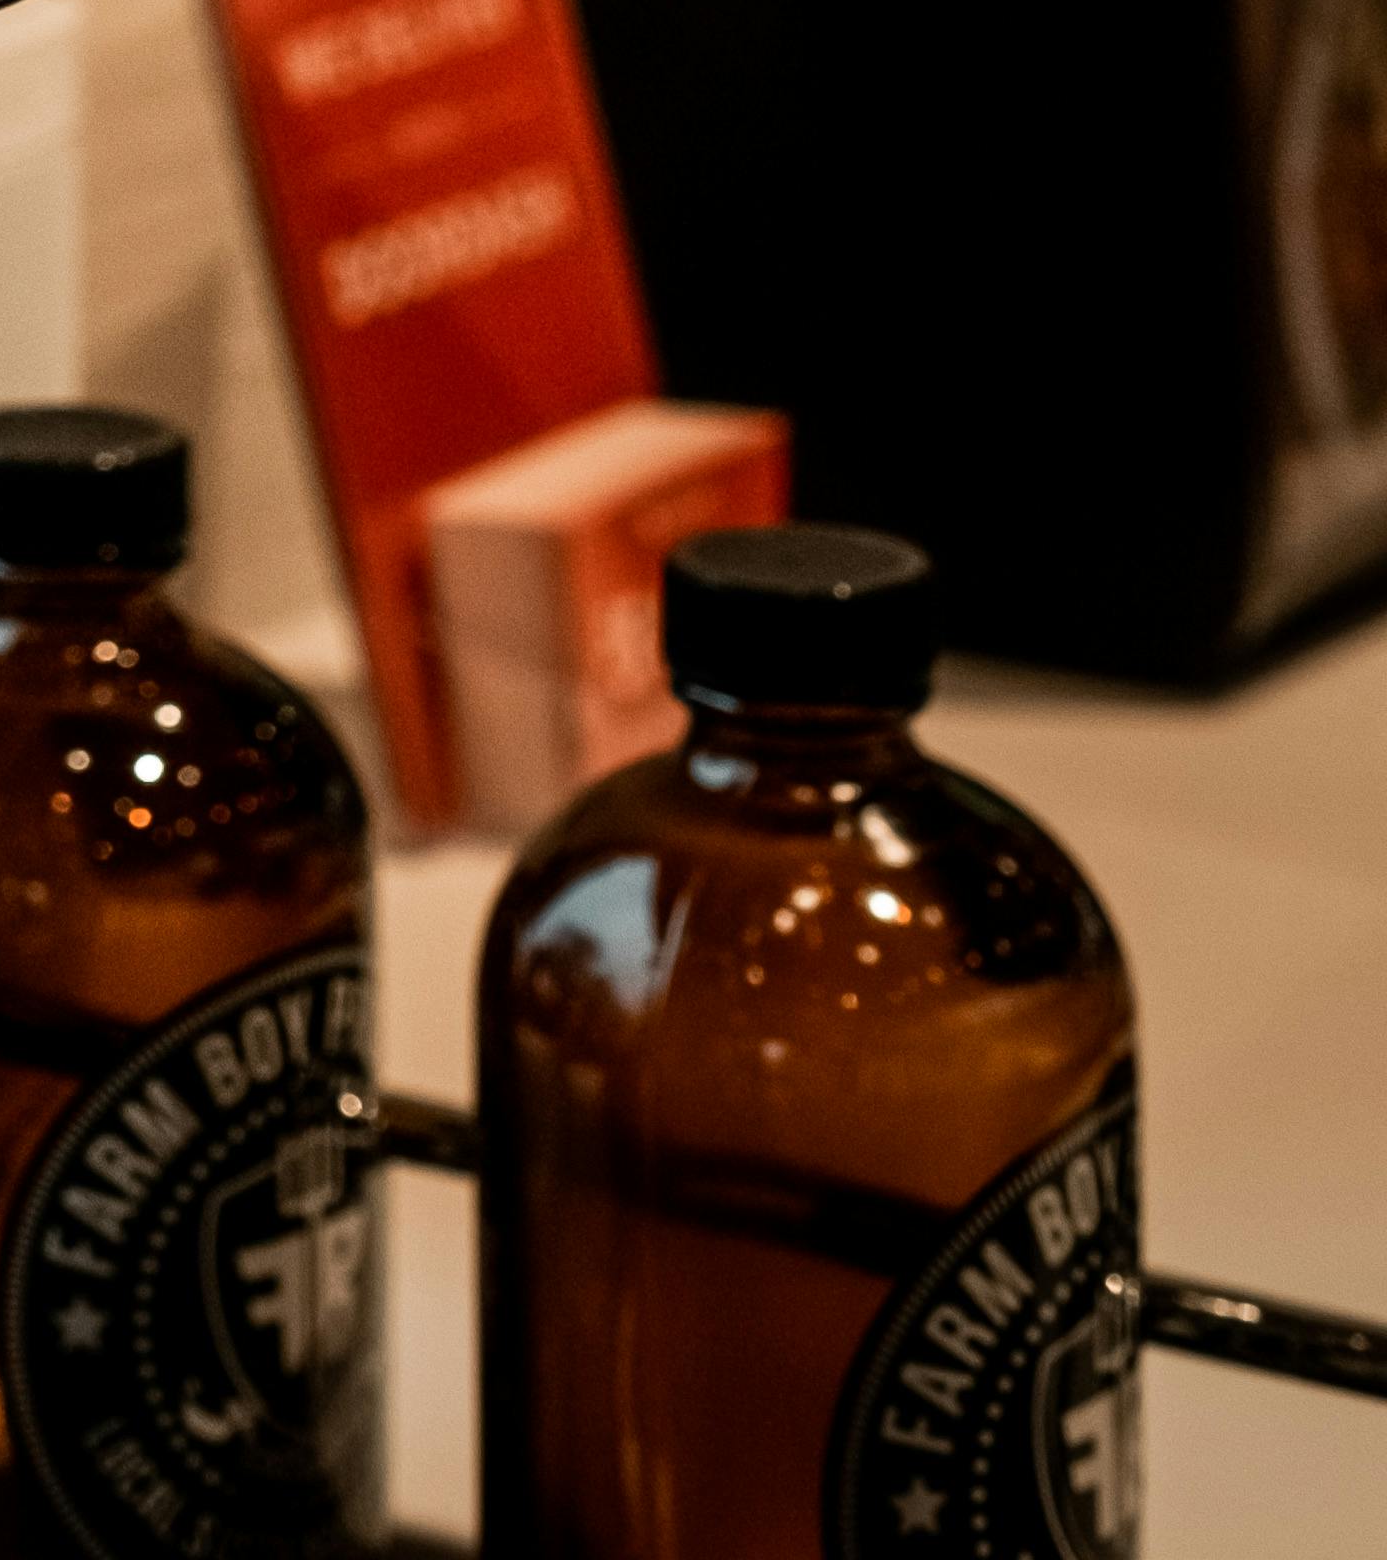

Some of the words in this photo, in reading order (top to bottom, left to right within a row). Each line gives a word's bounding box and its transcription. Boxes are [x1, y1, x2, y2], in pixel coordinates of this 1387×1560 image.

[36, 1073, 207, 1284] FARM
[190, 983, 316, 1113] BOY
[876, 1236, 1037, 1457] FARM
